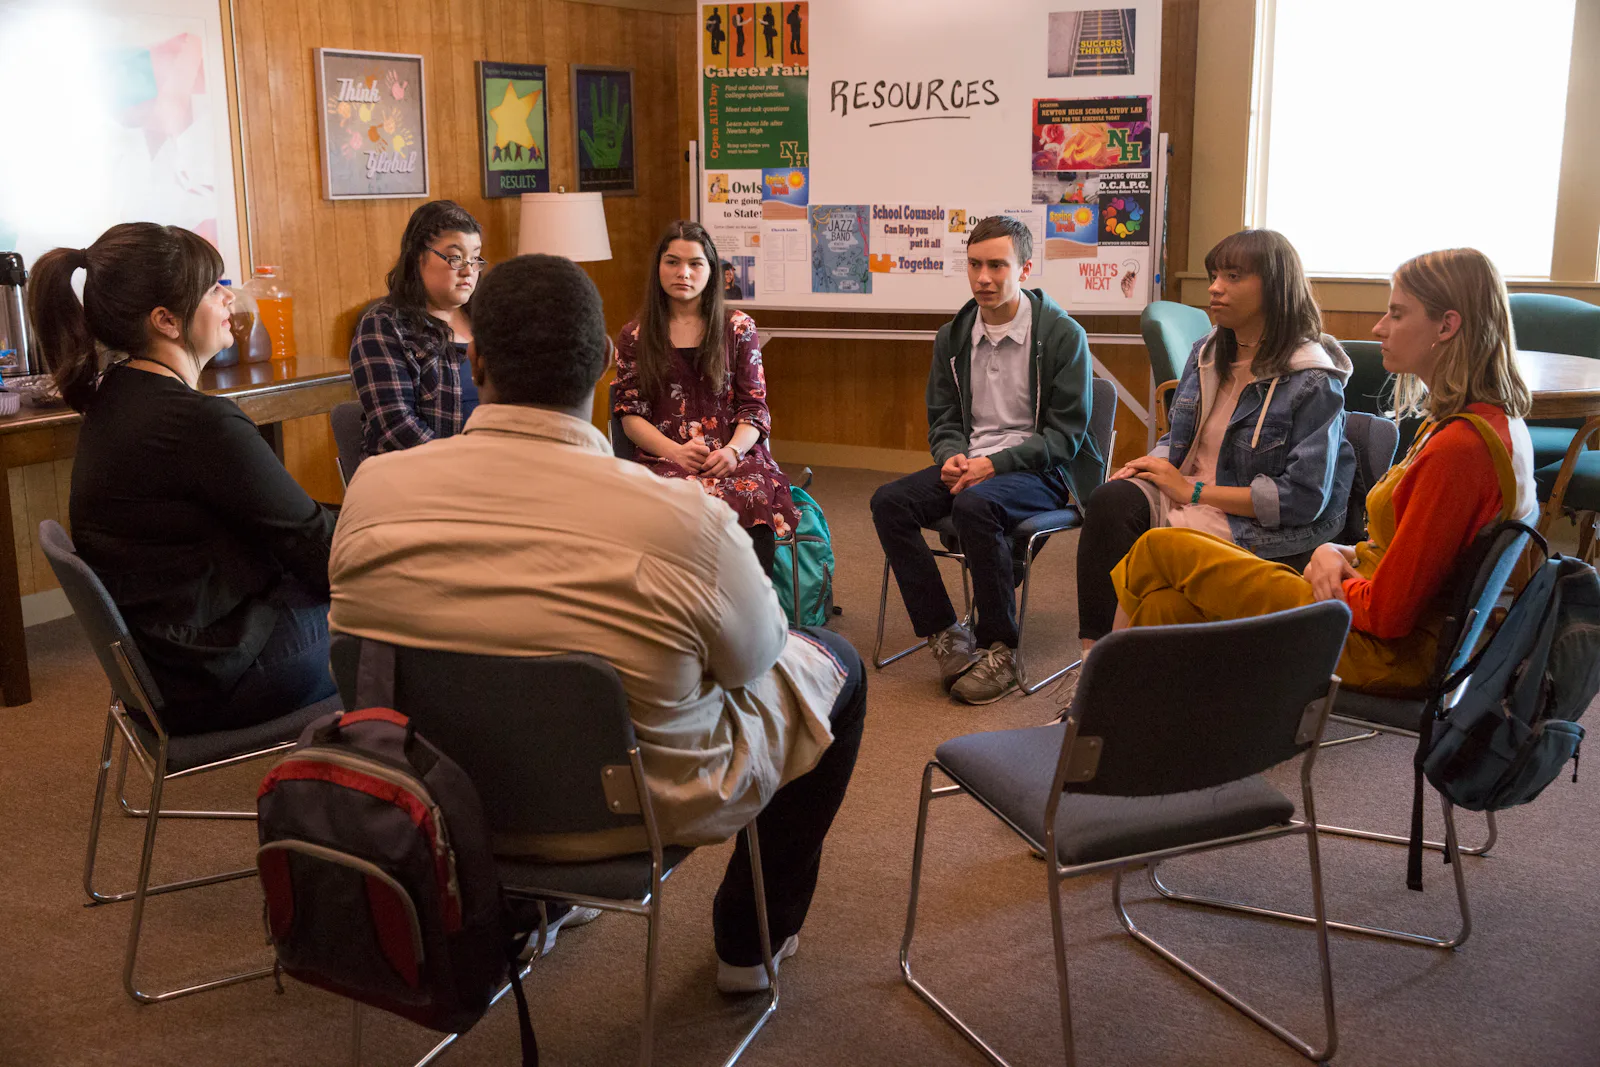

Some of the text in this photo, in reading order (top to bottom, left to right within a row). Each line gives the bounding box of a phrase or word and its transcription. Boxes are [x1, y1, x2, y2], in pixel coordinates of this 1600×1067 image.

[704, 62, 808, 78] Career Fair
[337, 78, 381, 103] Think
[830, 79, 1000, 117] RESOURCES
[709, 84, 720, 158] Open All Day
[364, 151, 416, 179] Global
[500, 175, 536, 188] RESULTS
[732, 182, 762, 194] Owls
[1100, 181, 1149, 189] O.C.A.P.G.
[741, 197, 762, 206] going
[734, 208, 762, 218] State!
[873, 205, 945, 220] School Counselo
[1050, 210, 1072, 223] Spring
[828, 220, 852, 232] JAZZ
[884, 224, 928, 237] Can Help you
[832, 232, 850, 241] BAND
[910, 239, 940, 250] put it all
[899, 257, 943, 272] Together
[1079, 263, 1118, 277] WHAT'S
[1085, 277, 1111, 290] NEXT
